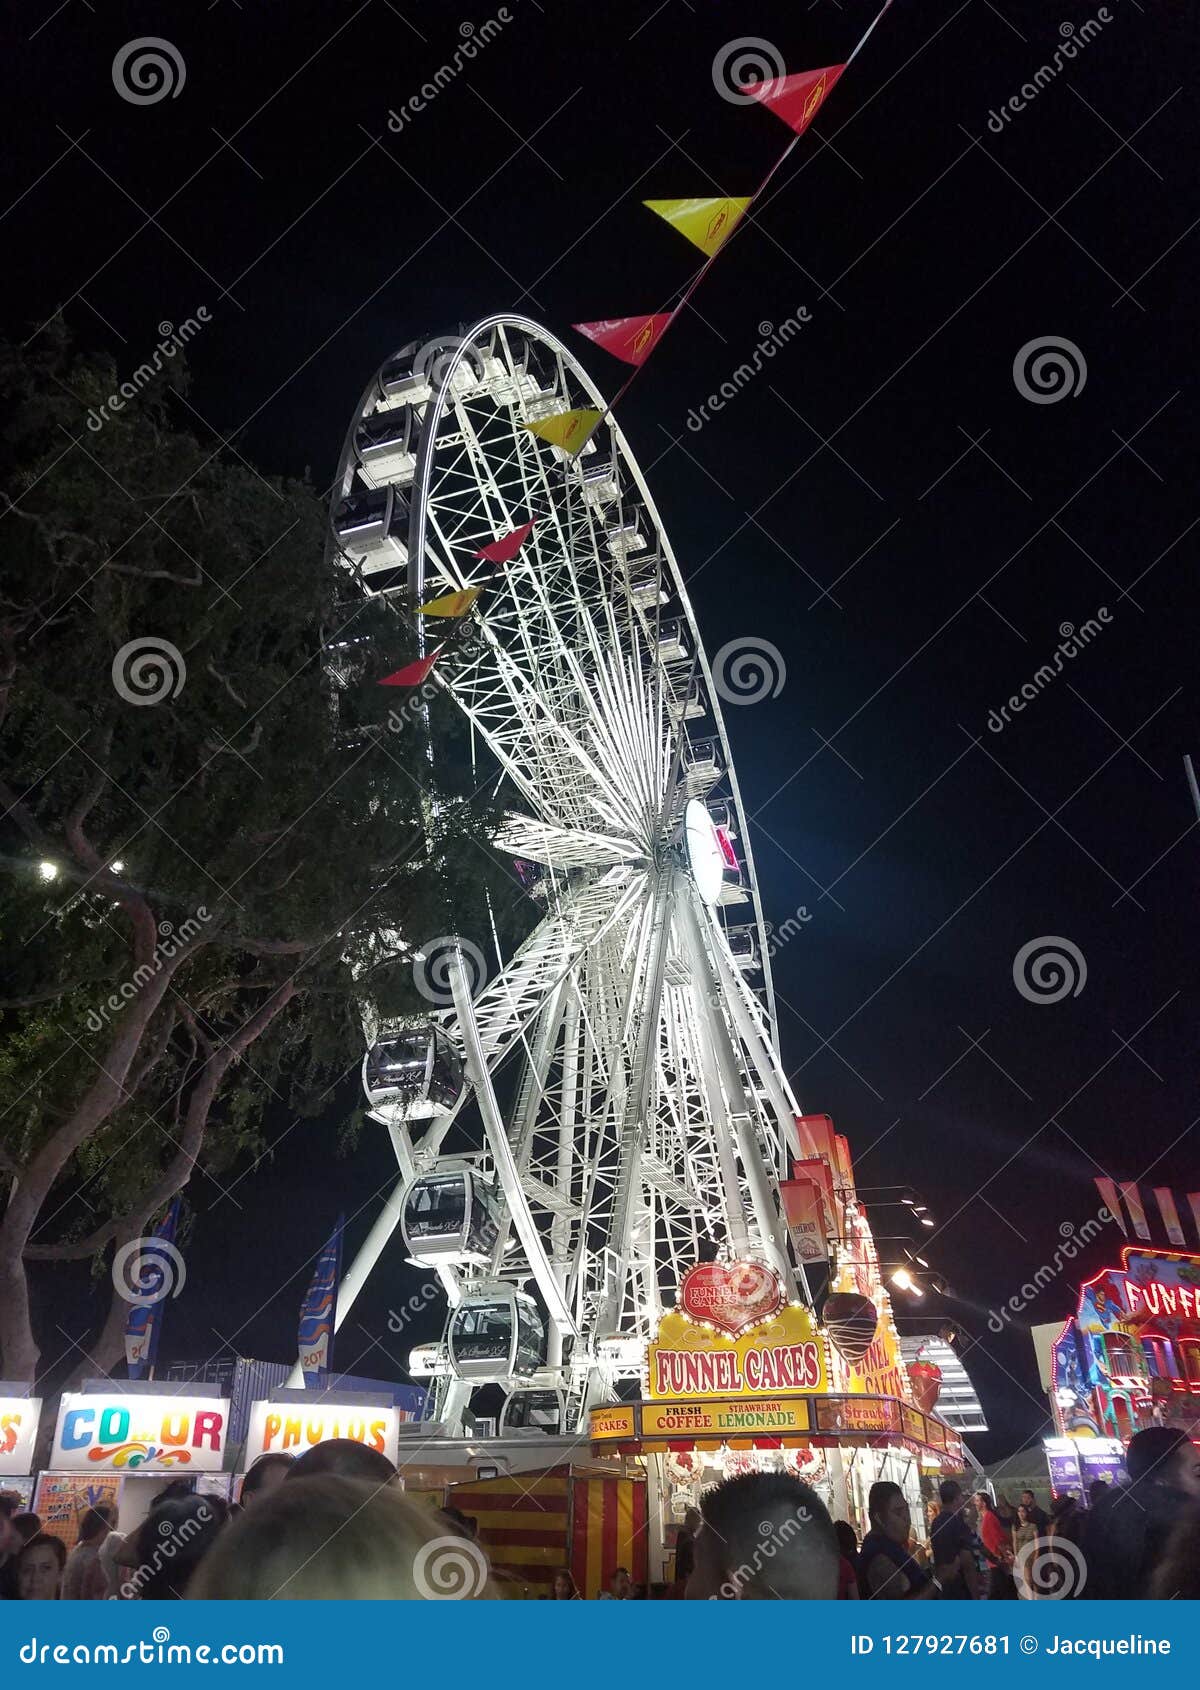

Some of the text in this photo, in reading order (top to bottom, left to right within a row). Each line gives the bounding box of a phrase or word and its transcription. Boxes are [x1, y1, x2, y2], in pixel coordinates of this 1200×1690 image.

[690, 1287, 737, 1298] FUNNEL
[691, 1296, 737, 1307] CAKES
[656, 1342, 820, 1394] FUNNEL CAKES
[665, 1407, 702, 1416] FRESH
[728, 1403, 782, 1412] STRAWBERRY
[600, 1419, 629, 1432] CAKES
[656, 1415, 713, 1429] COFFEE
[718, 1411, 796, 1428] LEMONADE
